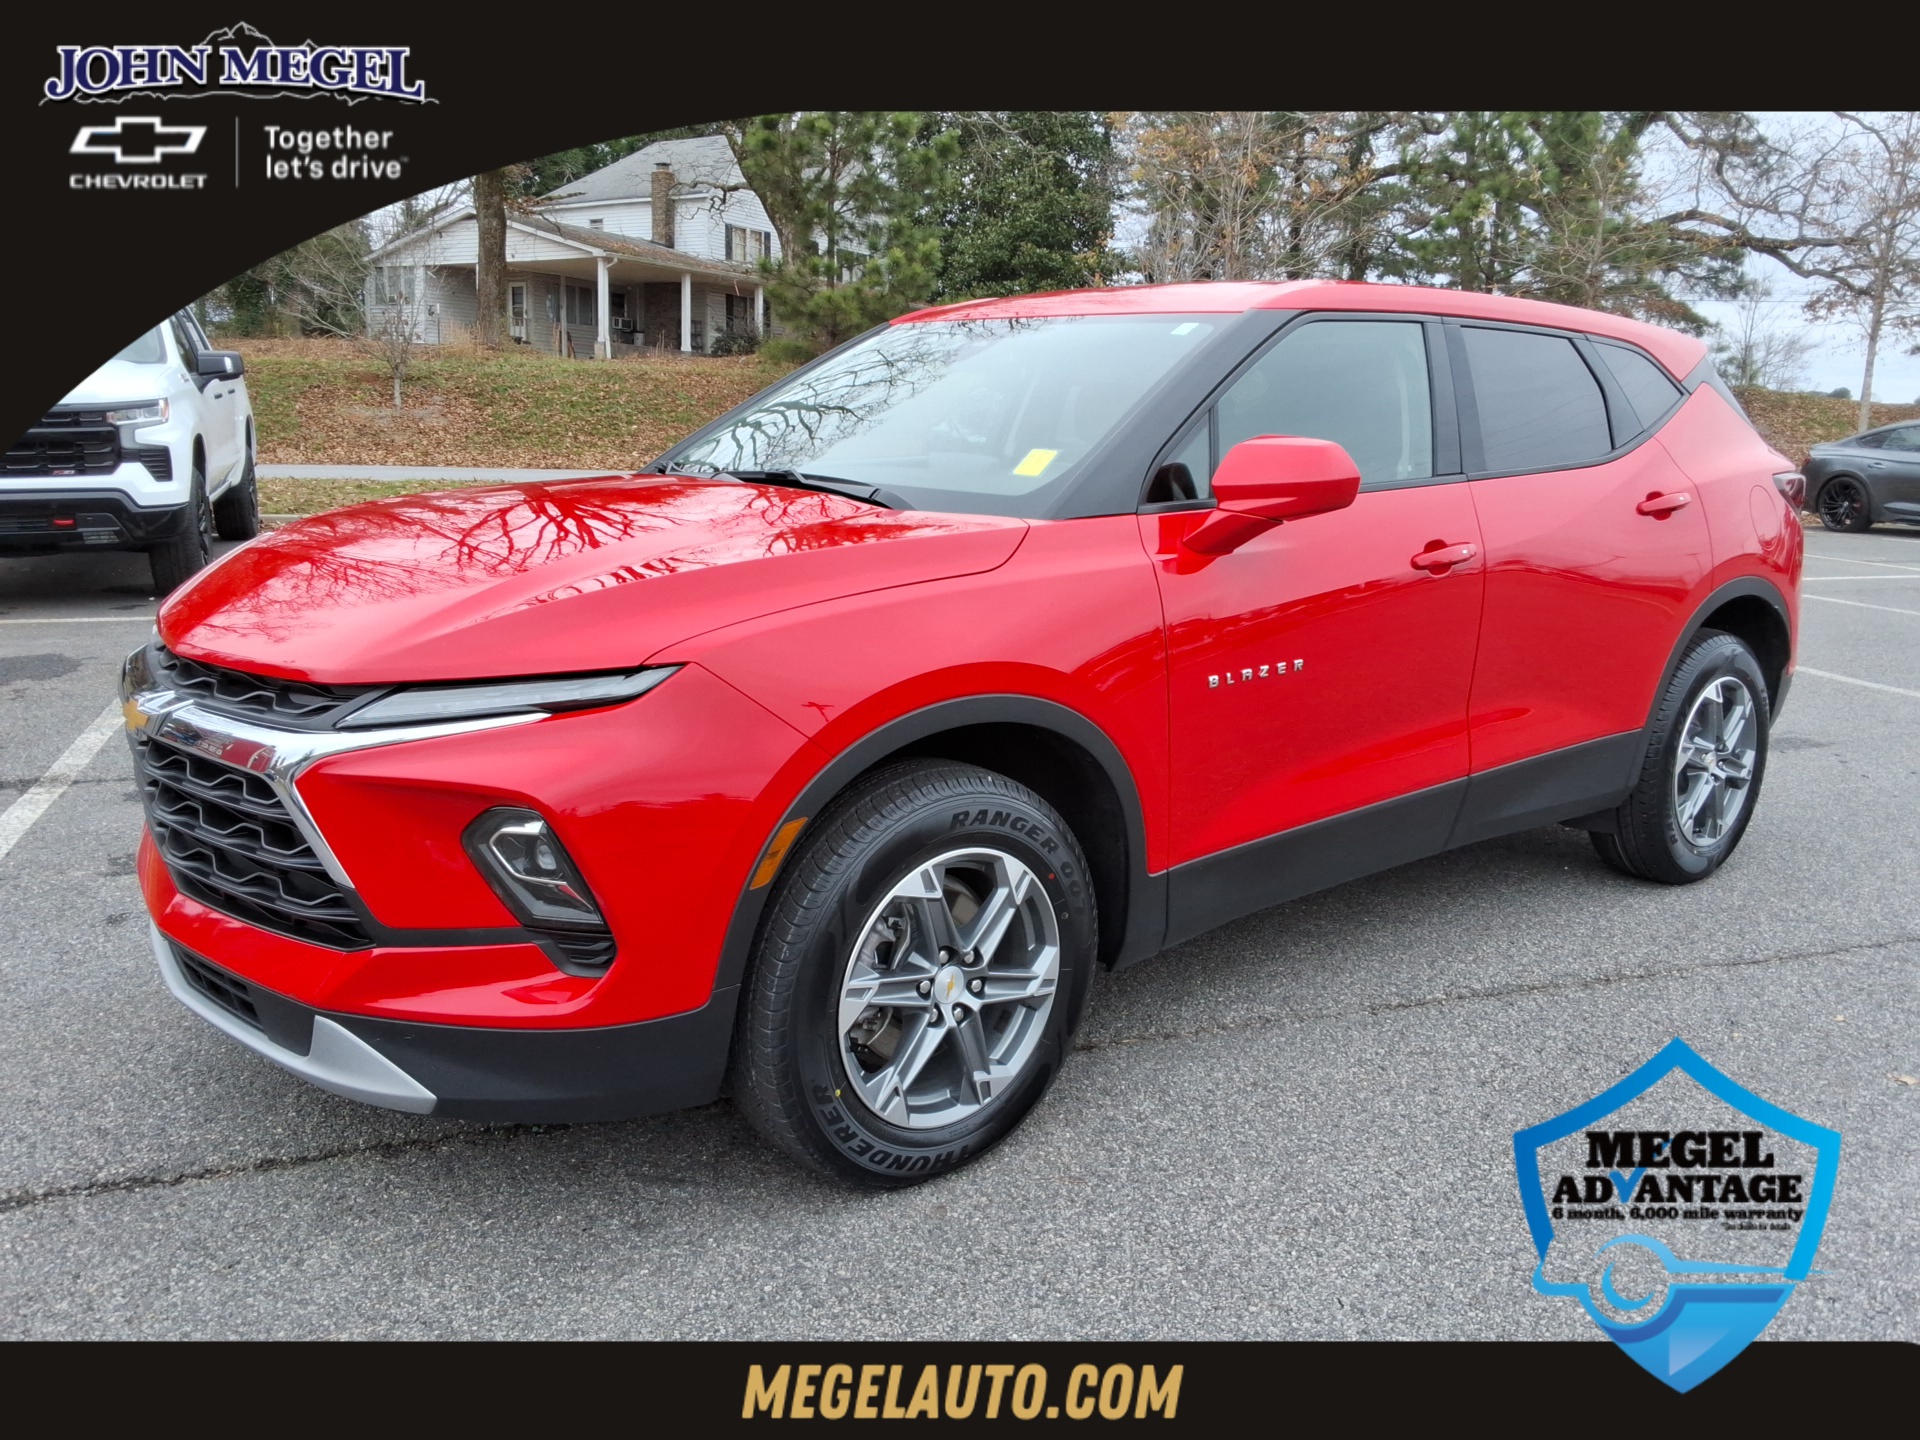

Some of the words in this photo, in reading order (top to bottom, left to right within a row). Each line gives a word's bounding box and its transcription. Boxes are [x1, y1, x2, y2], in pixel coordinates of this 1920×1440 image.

[1207, 658, 1305, 689] BLAZER
[949, 808, 1060, 856] RANGER
[812, 1084, 971, 1173] THUNDERER
